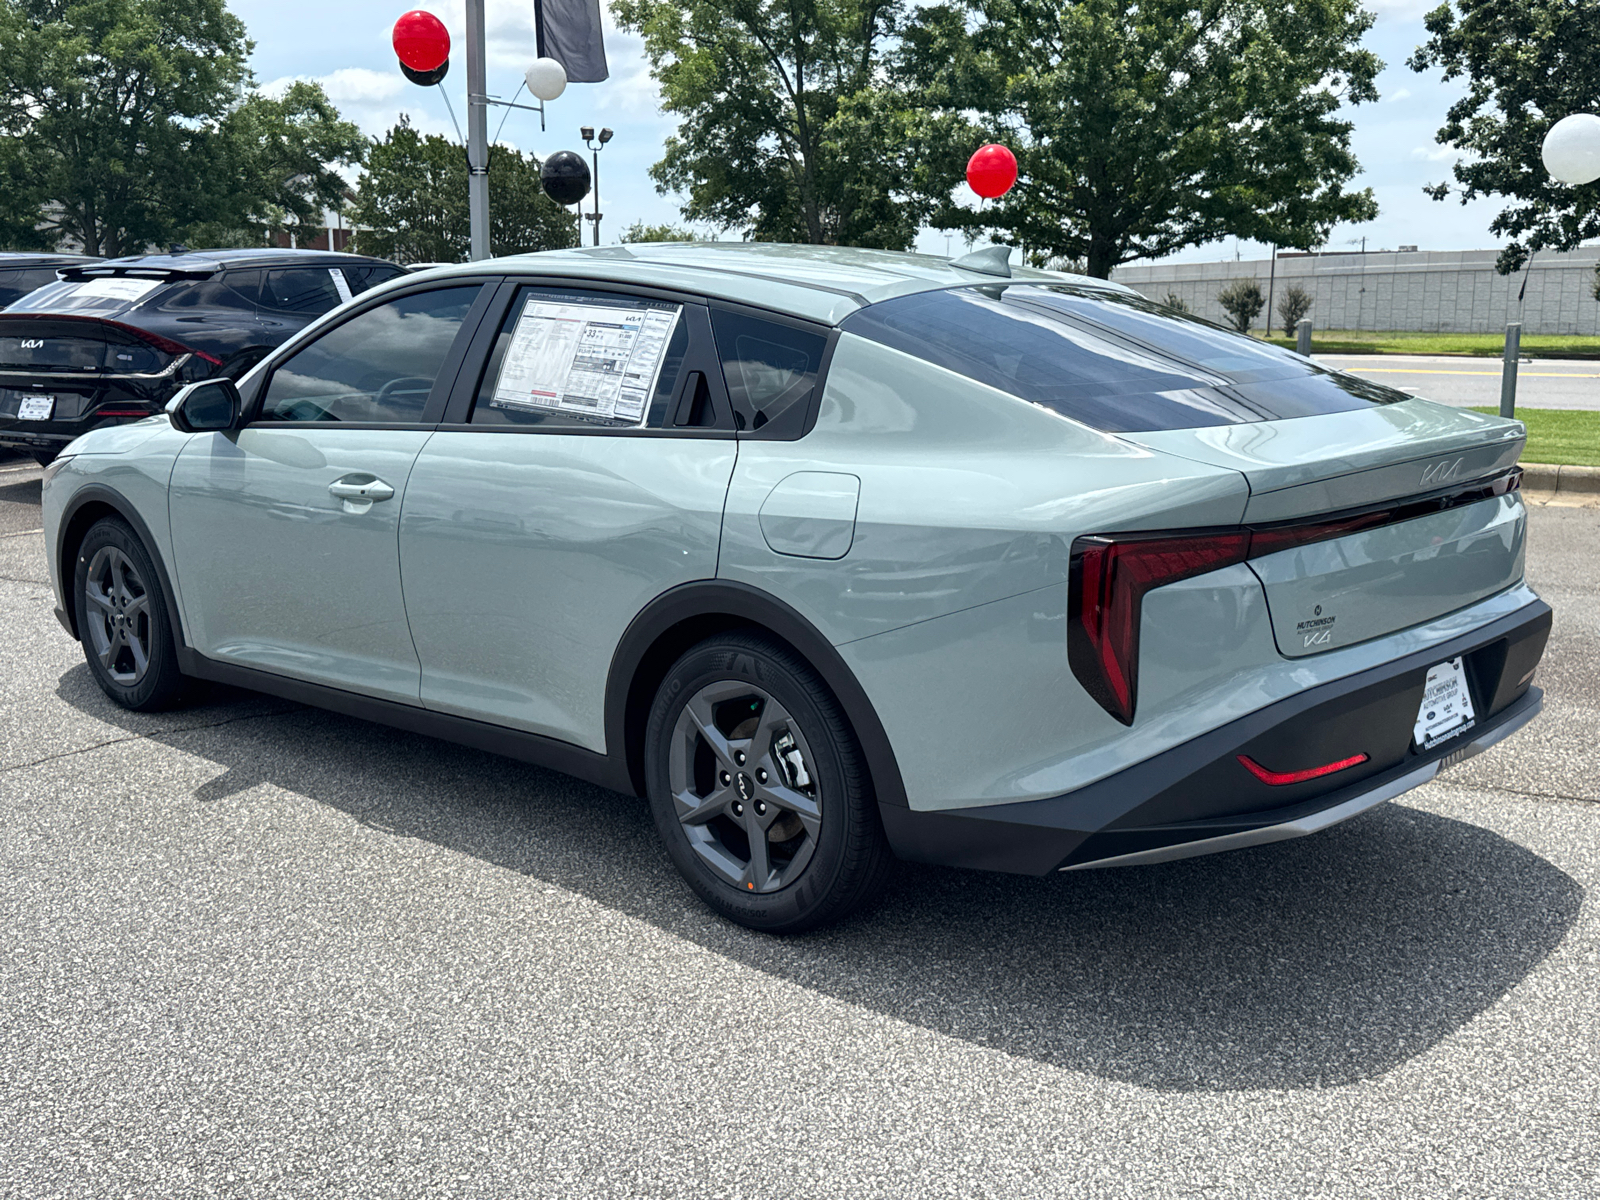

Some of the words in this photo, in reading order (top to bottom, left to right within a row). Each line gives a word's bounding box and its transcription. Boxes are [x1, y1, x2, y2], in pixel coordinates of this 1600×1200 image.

[586, 329, 597, 339] 33
[20, 339, 44, 349] KIA
[1418, 457, 1464, 486] KIA
[1296, 616, 1336, 630] HUTCHINSON
[1303, 630, 1331, 648] K4
